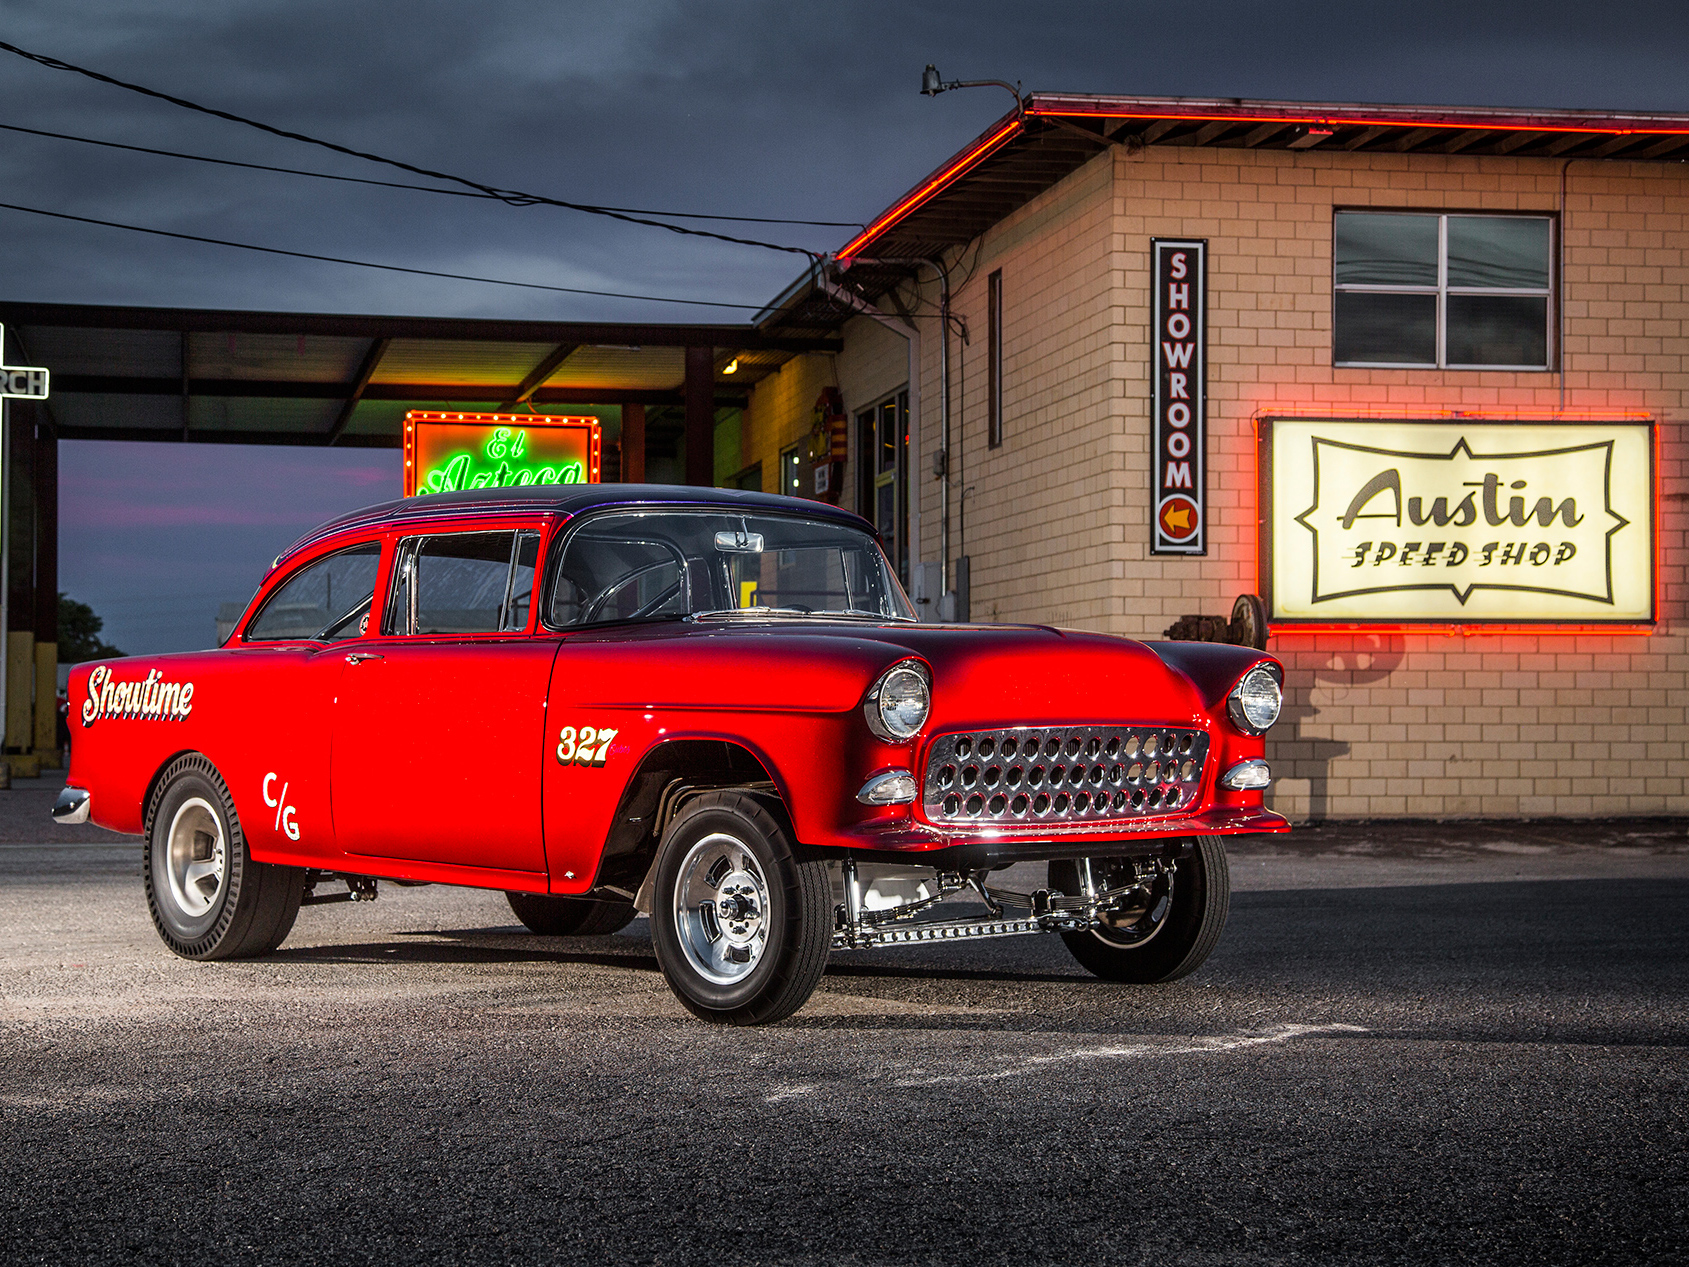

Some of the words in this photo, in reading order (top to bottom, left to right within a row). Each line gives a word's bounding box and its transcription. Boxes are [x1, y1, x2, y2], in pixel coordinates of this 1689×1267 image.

[1162, 252, 1196, 489] SHOWROOM
[486, 427, 527, 459] El
[1336, 468, 1585, 530] Austin
[1344, 541, 1470, 568] SPEED
[1474, 541, 1578, 568] SHOP
[82, 665, 194, 728] Showtime
[556, 725, 619, 768] 327
[262, 771, 301, 841] C/G
